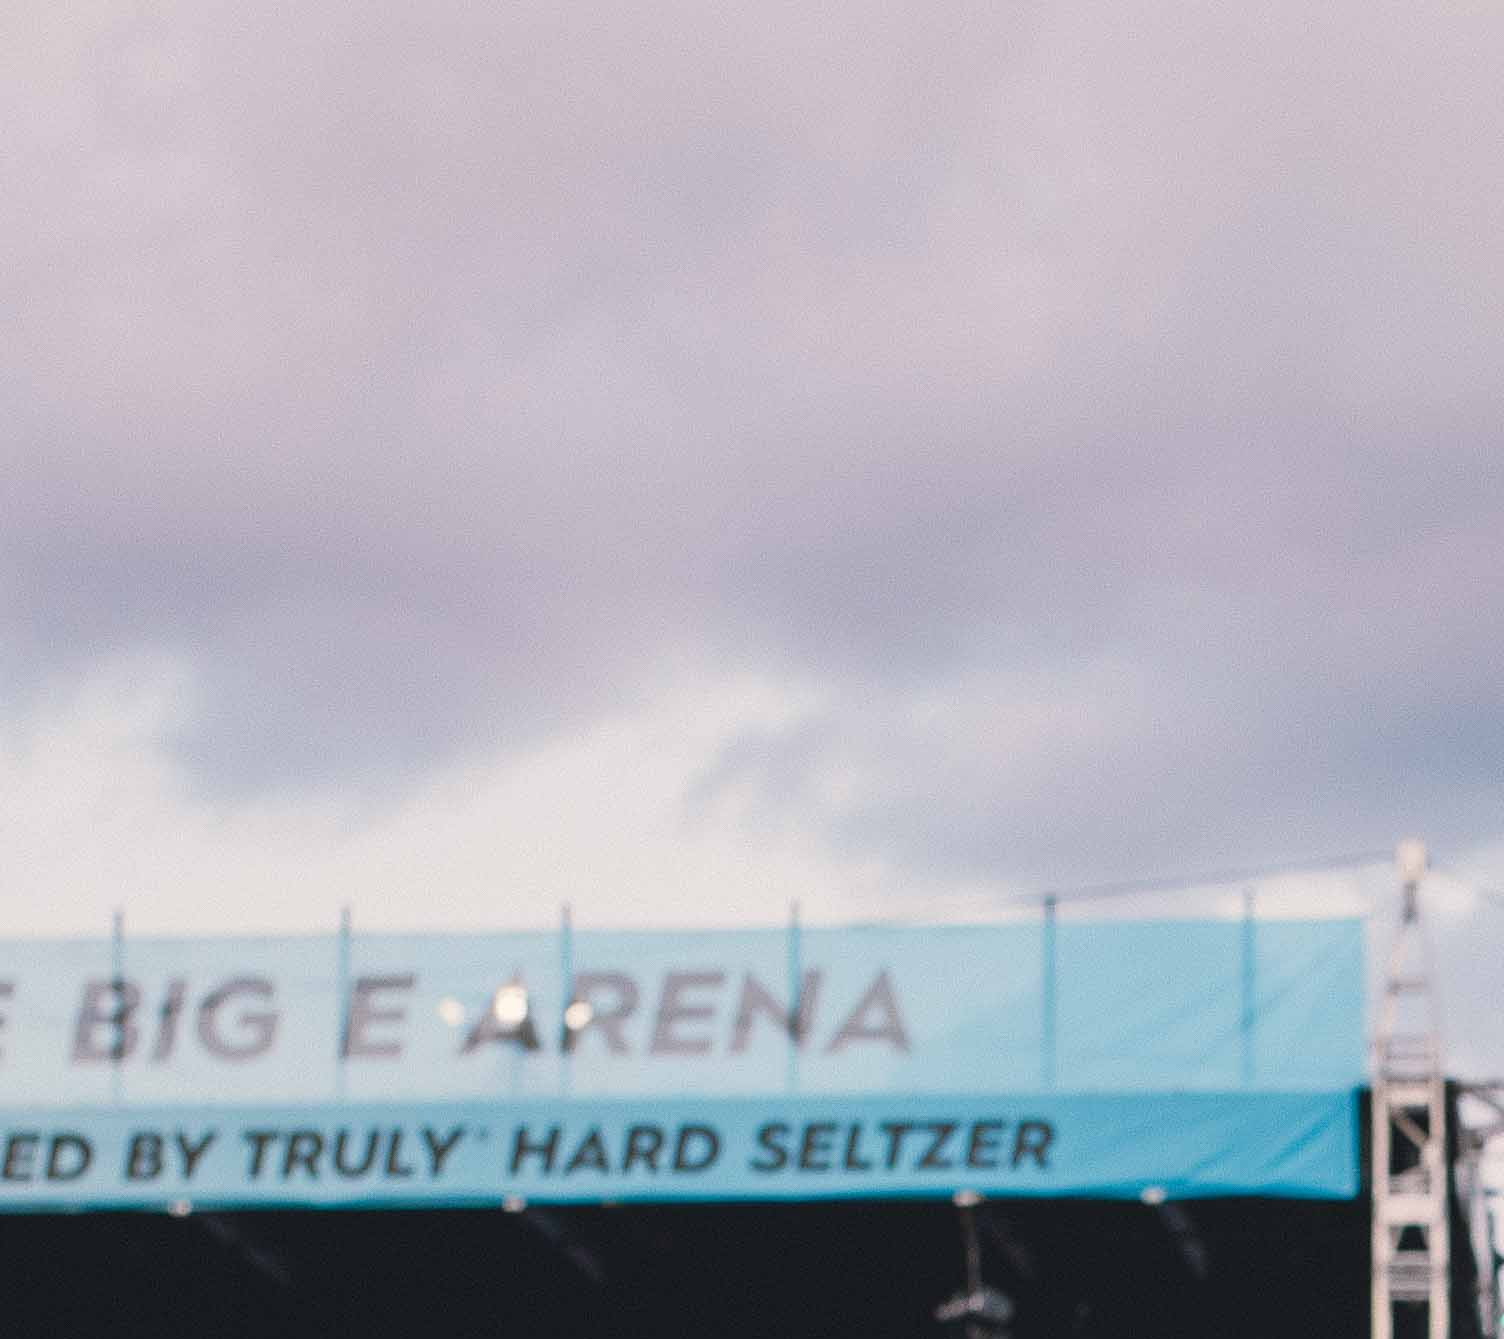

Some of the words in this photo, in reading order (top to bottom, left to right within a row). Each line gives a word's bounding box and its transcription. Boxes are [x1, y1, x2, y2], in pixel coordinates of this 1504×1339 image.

[70, 976, 277, 1065] BIG
[341, 973, 416, 1059] E
[460, 969, 913, 1058] ARENA
[124, 1129, 216, 1183] BY
[242, 1125, 465, 1180] TRULY
[508, 1122, 722, 1177] HARD
[749, 1118, 1056, 1174] SELTZER
